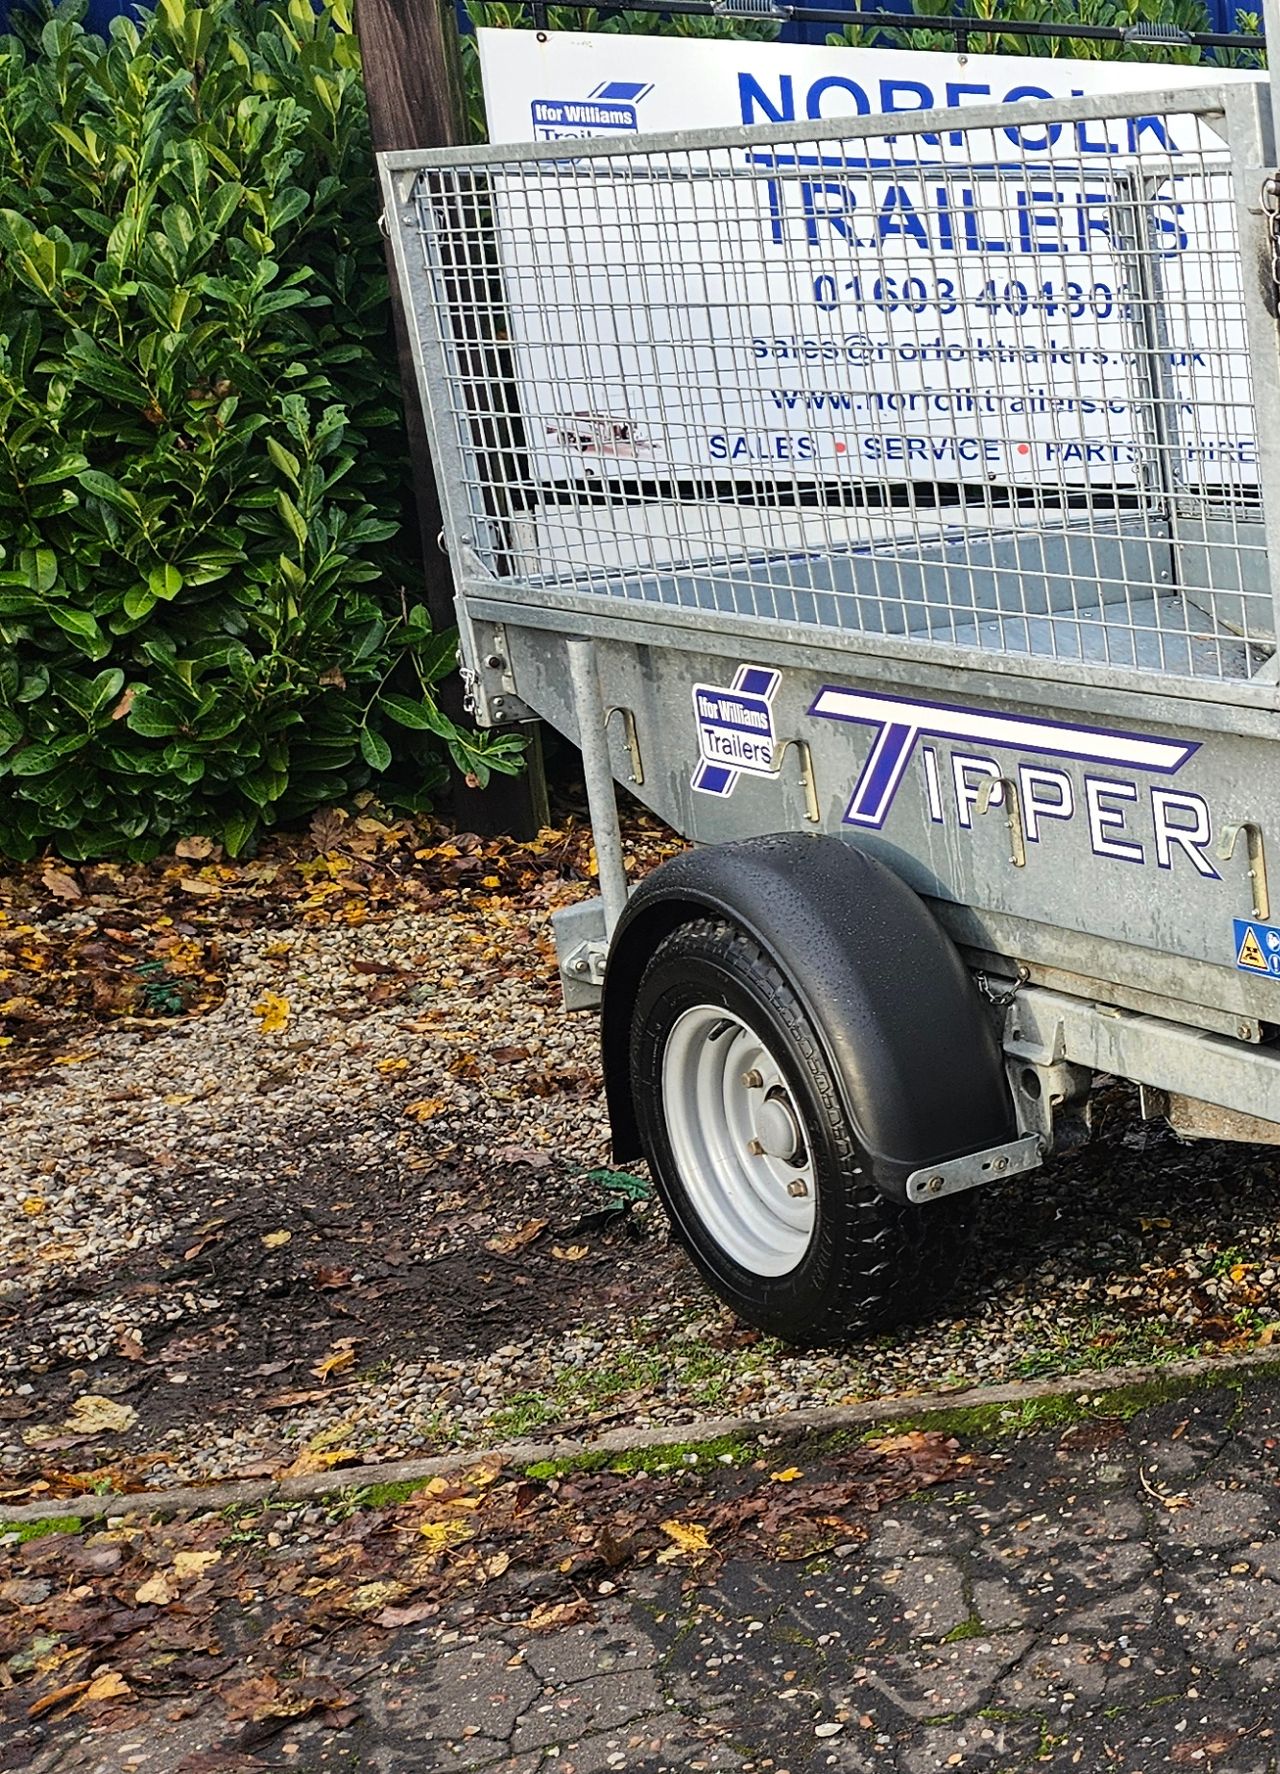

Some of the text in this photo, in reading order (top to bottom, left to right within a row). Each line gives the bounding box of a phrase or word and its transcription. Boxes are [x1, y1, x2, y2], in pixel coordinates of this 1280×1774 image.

[535, 103, 633, 125] Ifor Williams
[744, 152, 1189, 258] TRAILERS
[812, 274, 955, 314] 01603
[708, 434, 817, 461] SALES
[864, 437, 1001, 461] SERVICE
[698, 695, 768, 730] Ifor Williams
[703, 727, 772, 765] Trailers
